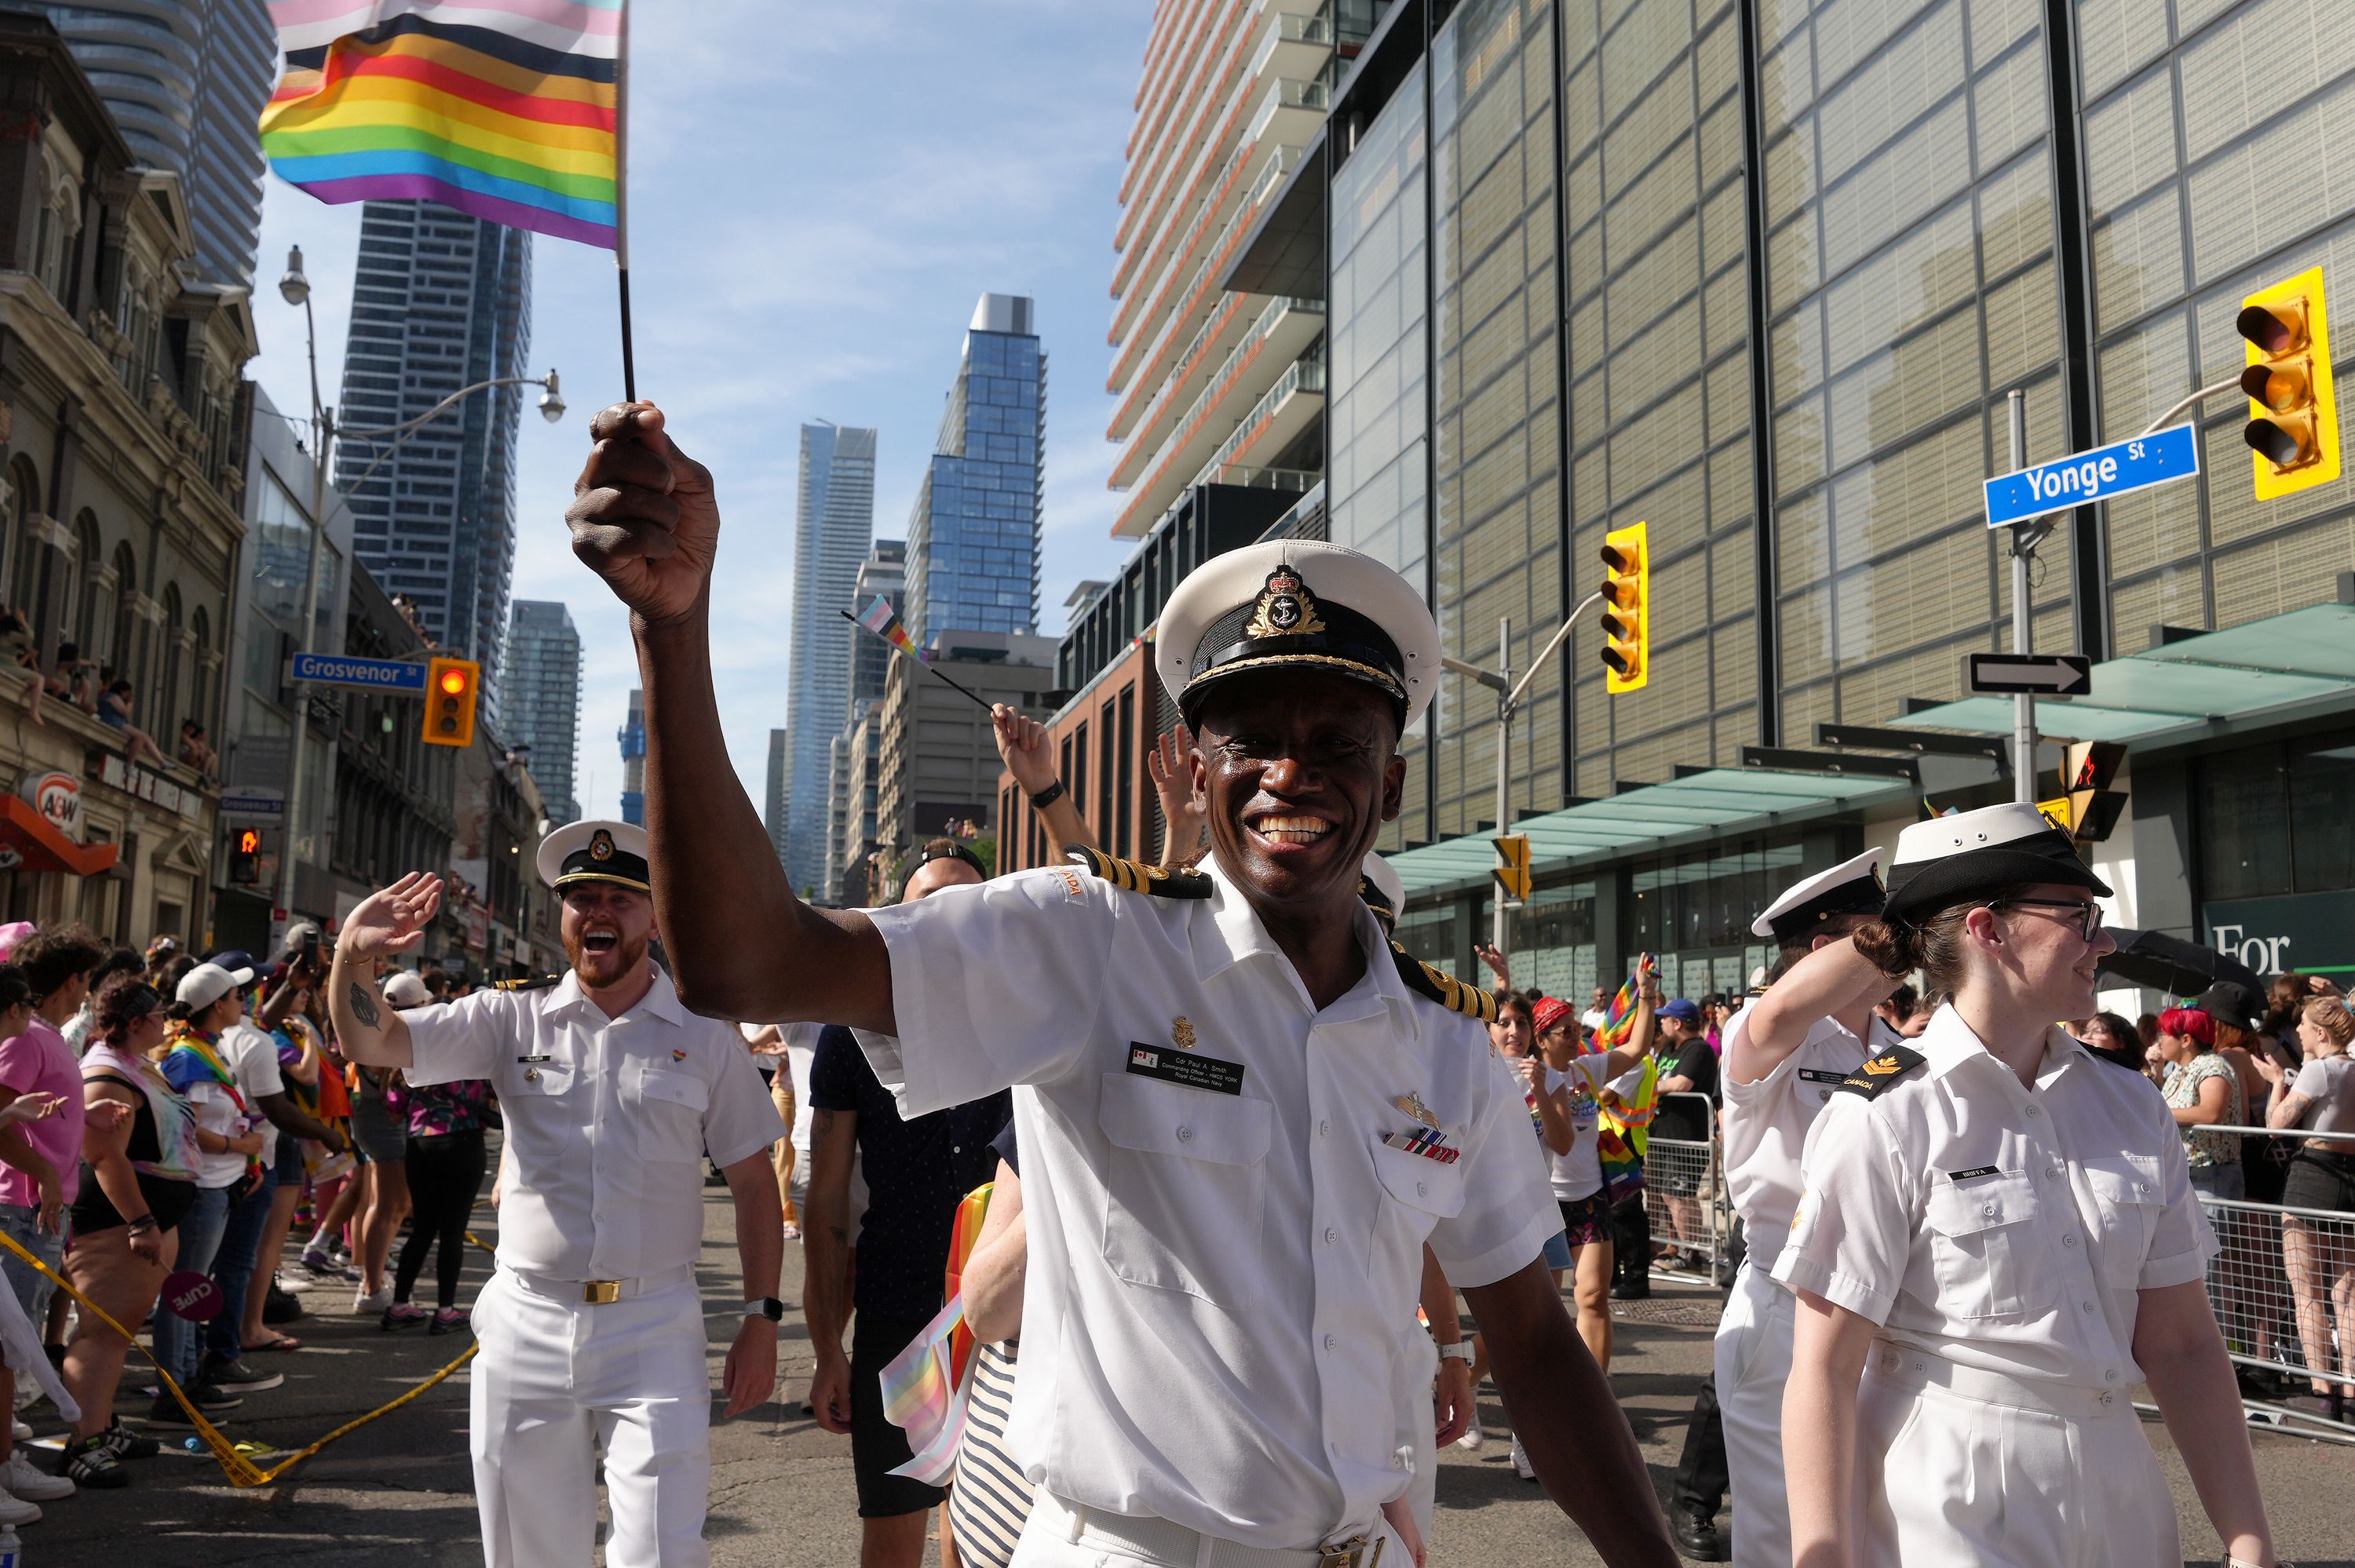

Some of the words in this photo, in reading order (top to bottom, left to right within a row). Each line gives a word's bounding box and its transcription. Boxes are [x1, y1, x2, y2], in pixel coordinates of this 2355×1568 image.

[2025, 457, 2118, 501] Yonge
[2128, 442, 2145, 461] St
[301, 657, 400, 682] Grosvenor
[407, 665, 417, 676] St
[44, 793, 78, 822] A&W
[2212, 924, 2291, 975] For
[1162, 1063, 1189, 1074] Commanding
[1188, 1059, 1201, 1068] Paul
[1211, 1065, 1227, 1074] Smith
[1189, 1074, 1210, 1084] Canadian
[1844, 1079, 1874, 1090] CANADA
[173, 1282, 213, 1311] CUPE
